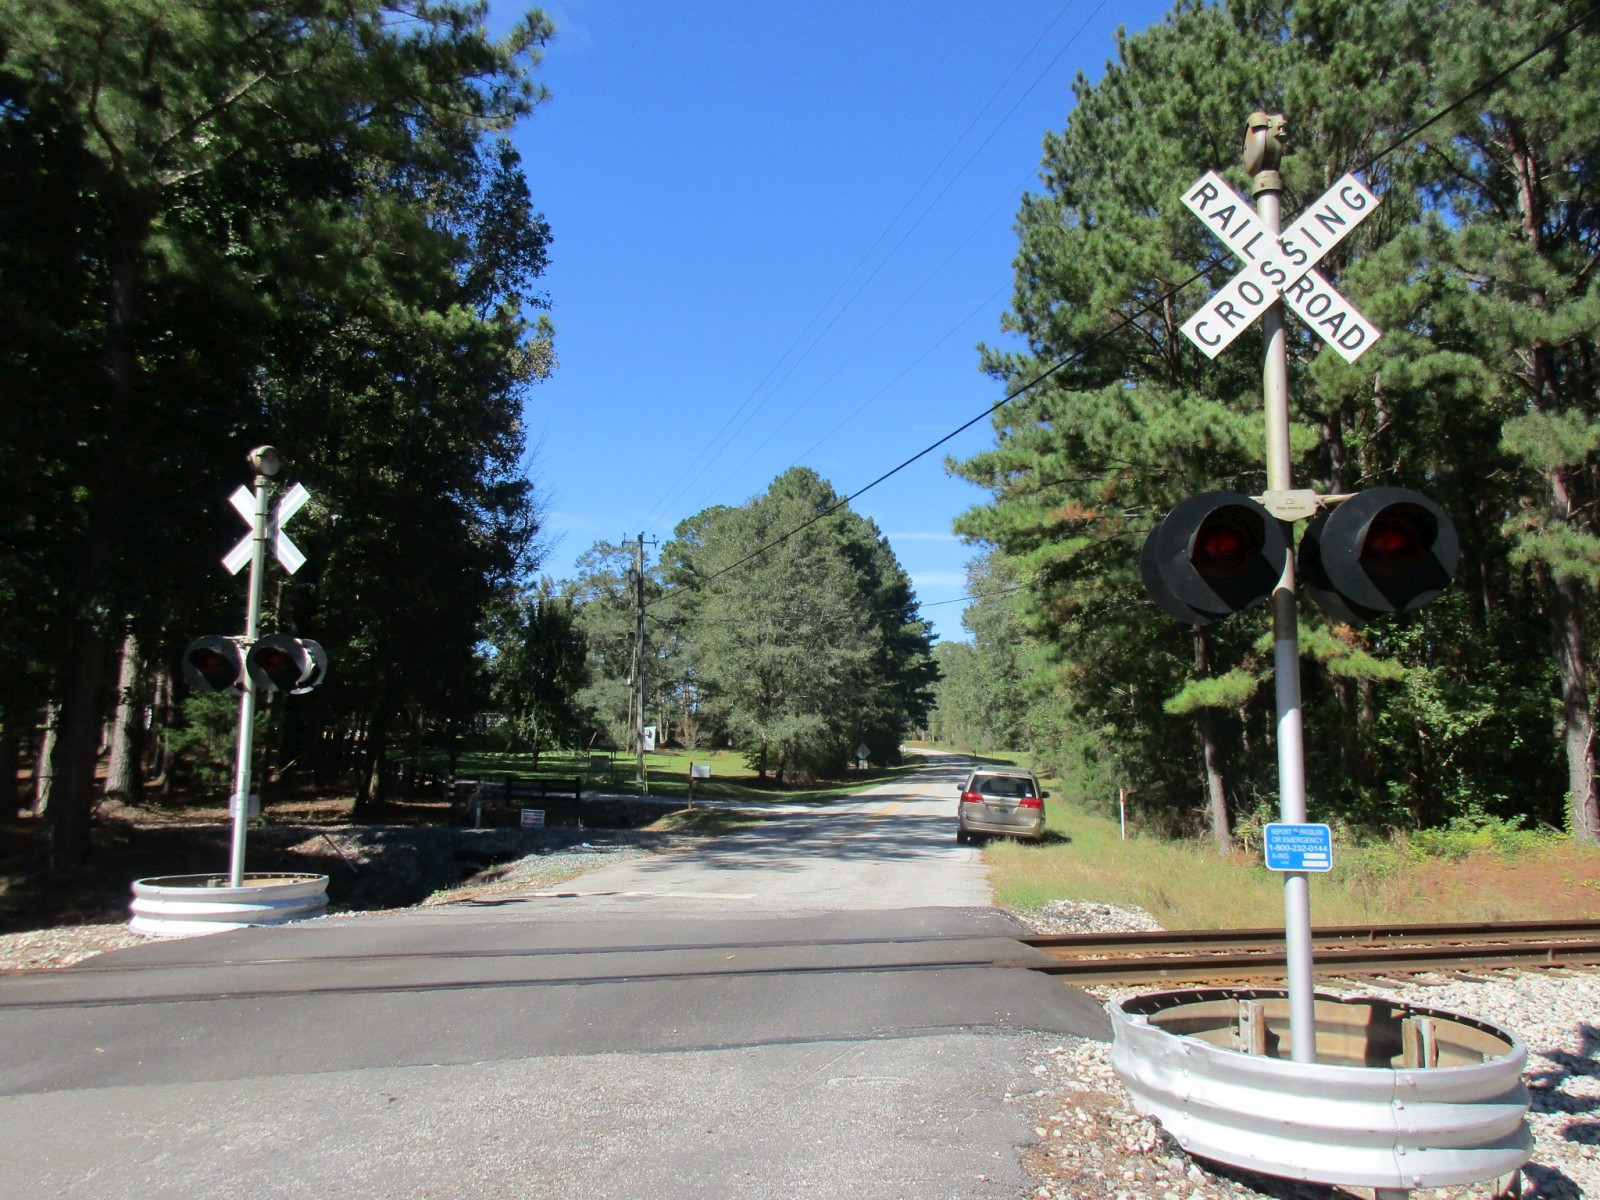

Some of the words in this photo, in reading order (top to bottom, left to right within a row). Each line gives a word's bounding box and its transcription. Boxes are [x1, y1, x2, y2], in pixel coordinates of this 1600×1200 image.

[1190, 181, 1264, 260] RAIL
[1286, 275, 1365, 351] ROAD
[1195, 186, 1366, 347] CROSSING
[1299, 828, 1324, 836] PROBLEM
[1282, 836, 1324, 844] EMERGENCY
[1269, 844, 1328, 852] 1-800-232-0144
